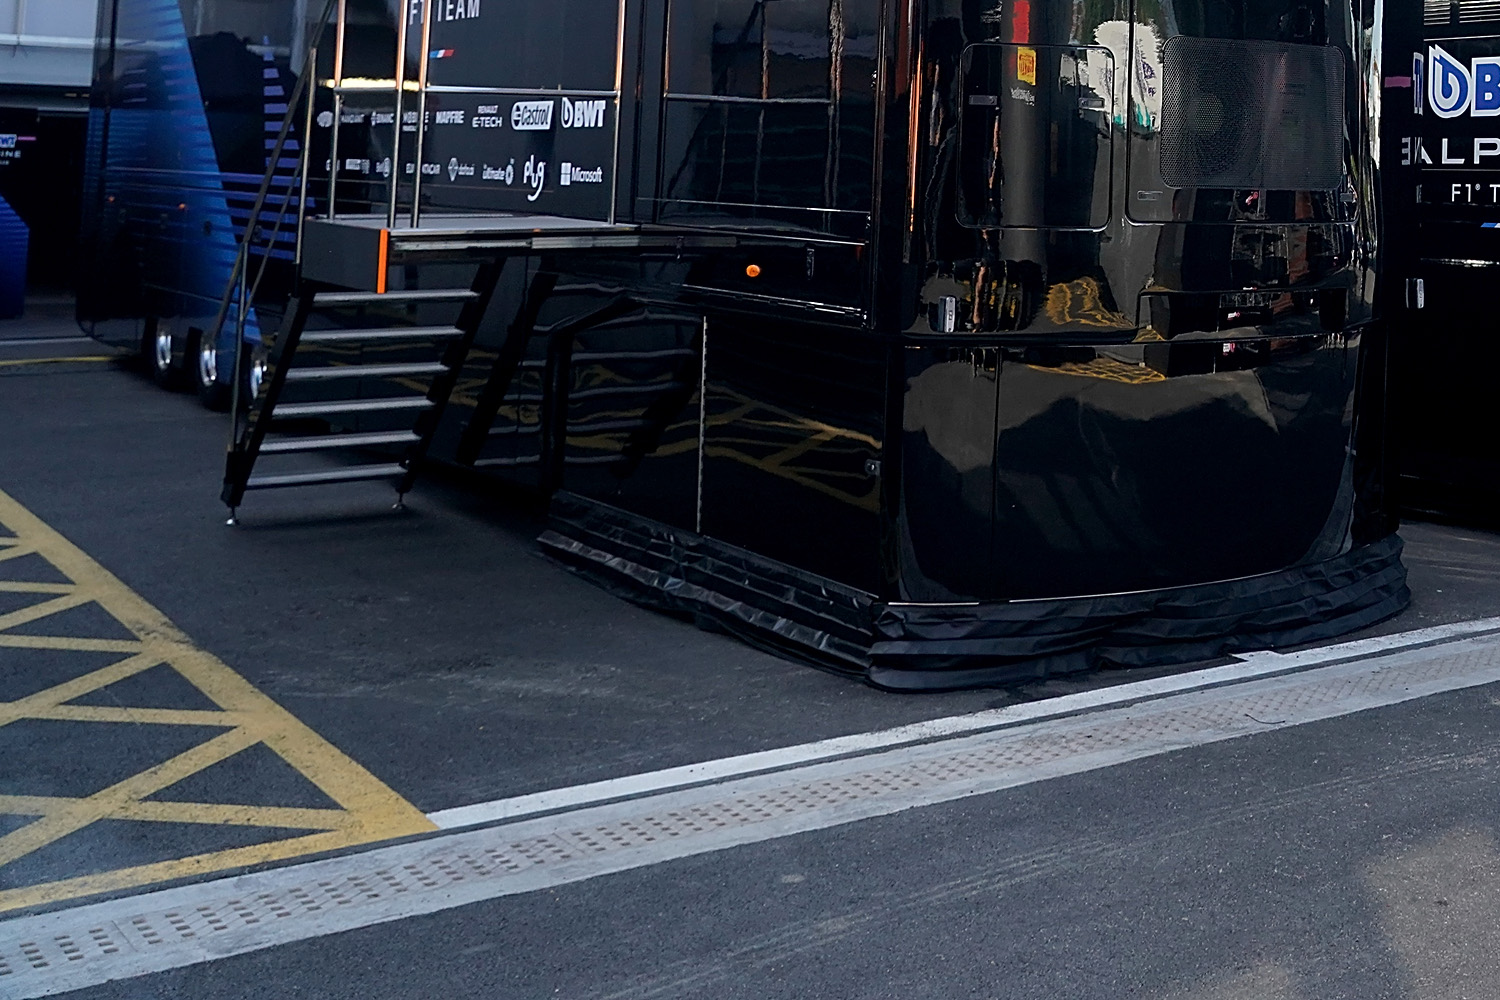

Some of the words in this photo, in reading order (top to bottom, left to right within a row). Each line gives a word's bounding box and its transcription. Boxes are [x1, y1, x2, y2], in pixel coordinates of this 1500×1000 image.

[472, 116, 502, 128] E-TECH
[520, 103, 551, 127] Castrol
[573, 100, 606, 128] BWT
[571, 166, 602, 183] Microsoft
